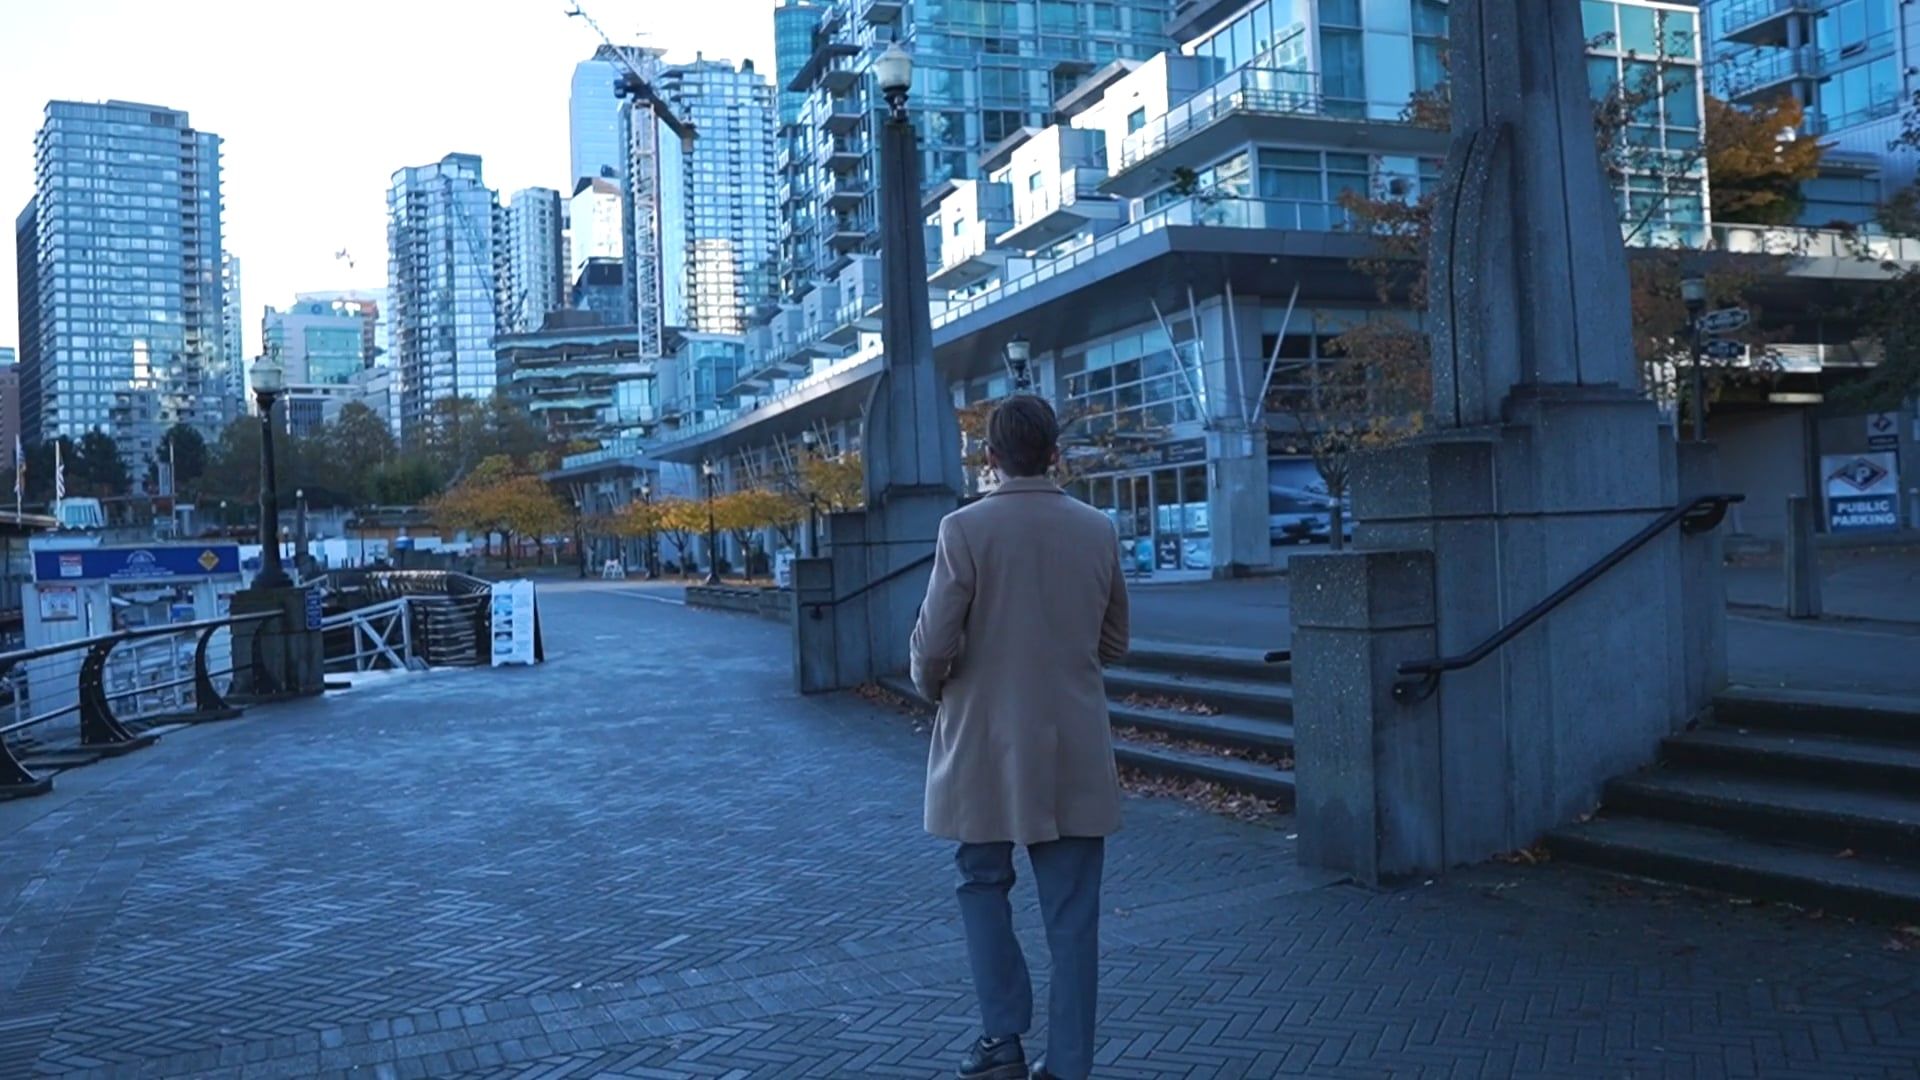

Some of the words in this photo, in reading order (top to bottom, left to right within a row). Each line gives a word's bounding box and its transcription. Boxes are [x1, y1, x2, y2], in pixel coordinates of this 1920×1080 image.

[1856, 467, 1871, 483] P
[1838, 501, 1889, 513] PUBLIC
[1832, 513, 1896, 526] PARKING
